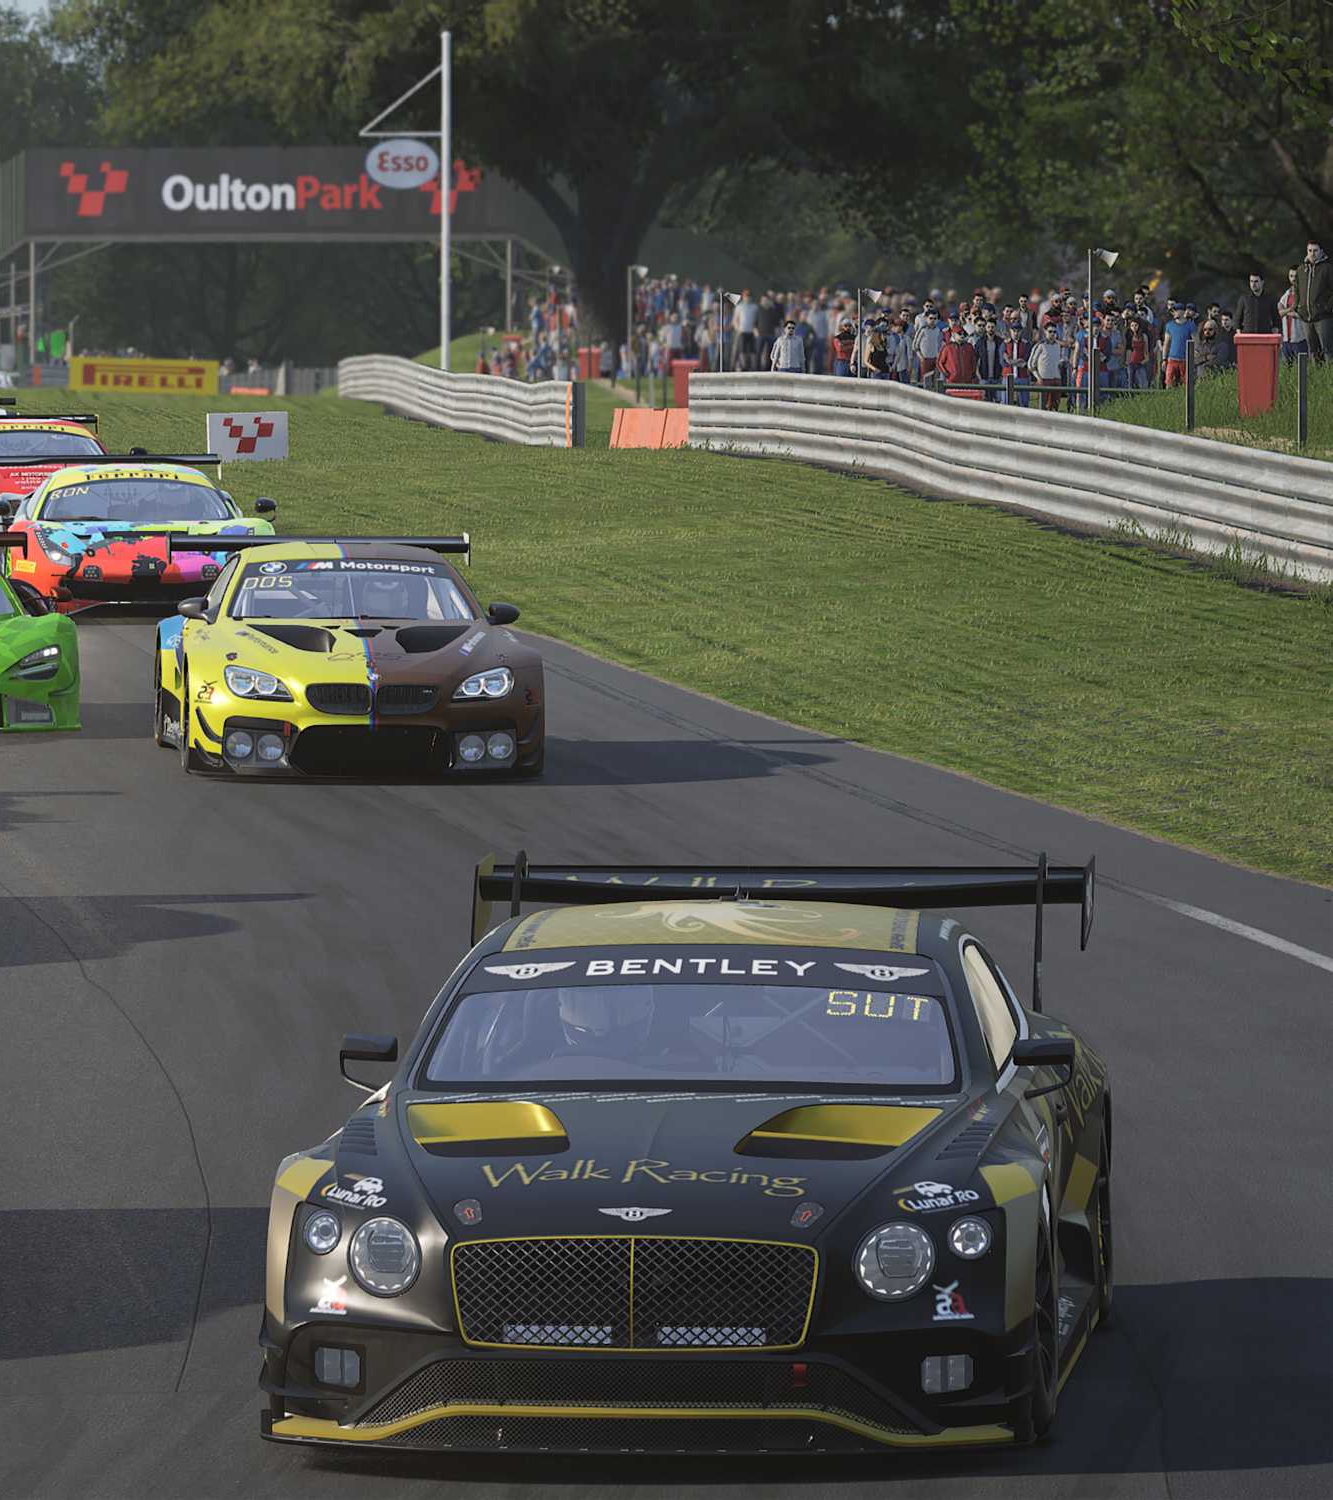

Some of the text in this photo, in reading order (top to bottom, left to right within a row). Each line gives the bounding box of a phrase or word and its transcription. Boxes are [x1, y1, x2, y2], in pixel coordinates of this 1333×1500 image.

[378, 152, 429, 173] Esso
[161, 173, 383, 212] OultonPark
[340, 561, 436, 574] Motorsport
[585, 958, 817, 977] BENTLEY
[826, 990, 929, 1021] SUT
[481, 1158, 808, 1197] Walk Racing
[908, 1195, 955, 1211] Lunar
